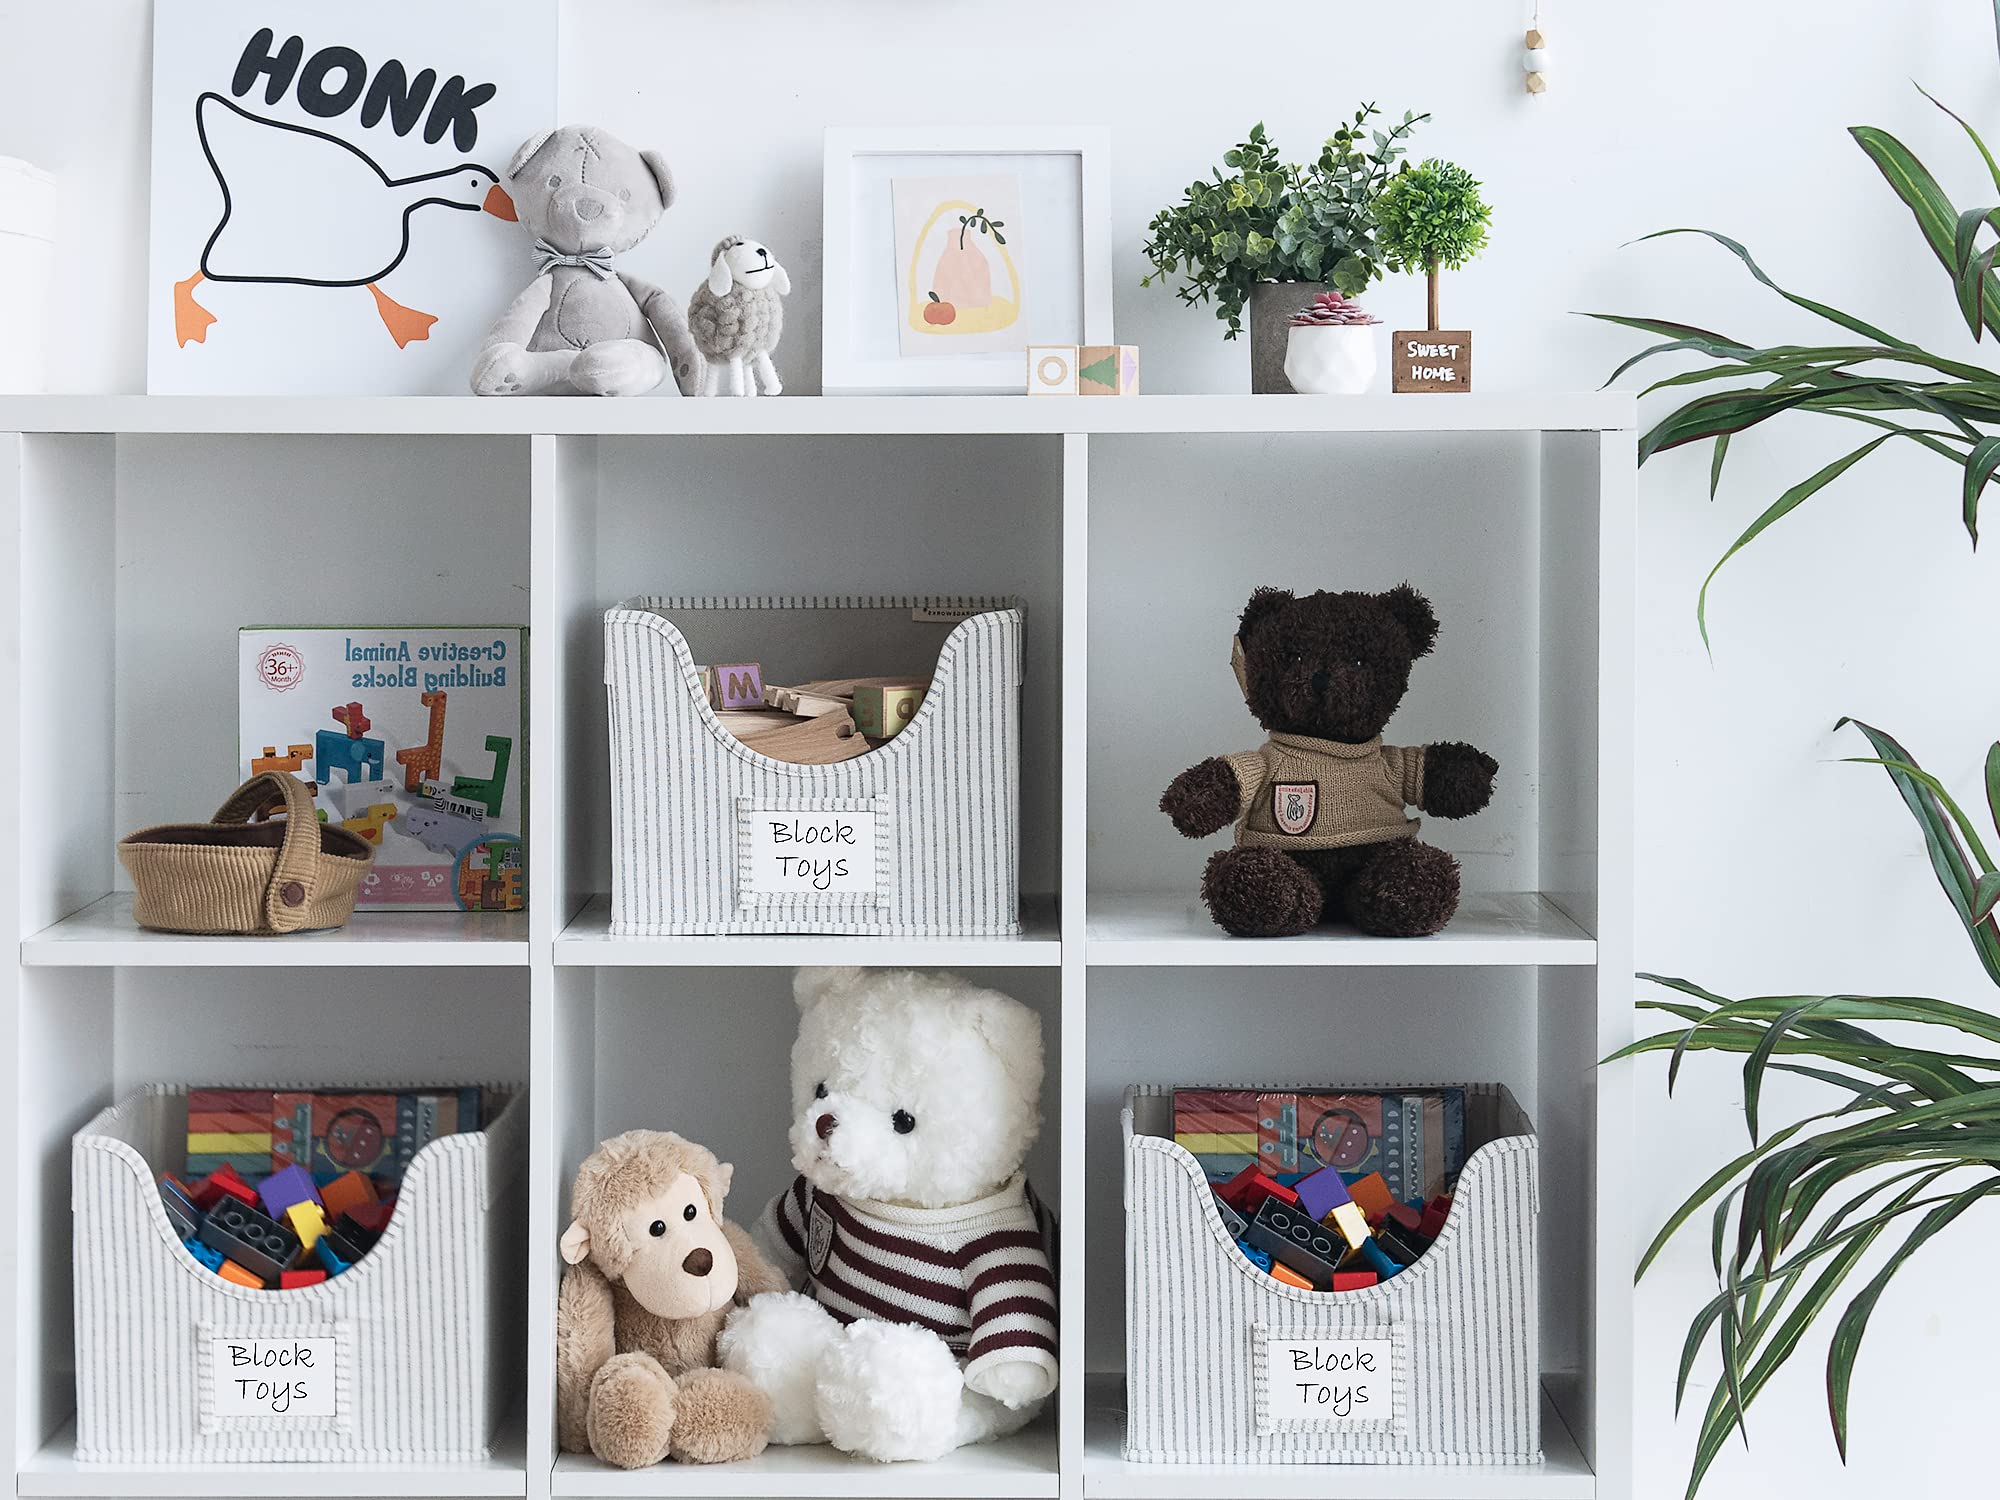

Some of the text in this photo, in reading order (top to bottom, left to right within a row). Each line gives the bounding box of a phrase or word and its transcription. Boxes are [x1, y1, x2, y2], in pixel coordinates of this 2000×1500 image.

[232, 27, 497, 153] HONK
[1407, 340, 1460, 361] SWEET
[1411, 365, 1456, 382] HOME
[267, 658, 295, 676] 36+
[769, 819, 856, 845] Block
[775, 856, 849, 890] Toys
[227, 1342, 315, 1368] Block
[1288, 1346, 1377, 1372] Block
[234, 1379, 308, 1412] Toys
[1295, 1383, 1369, 1417] Toys
